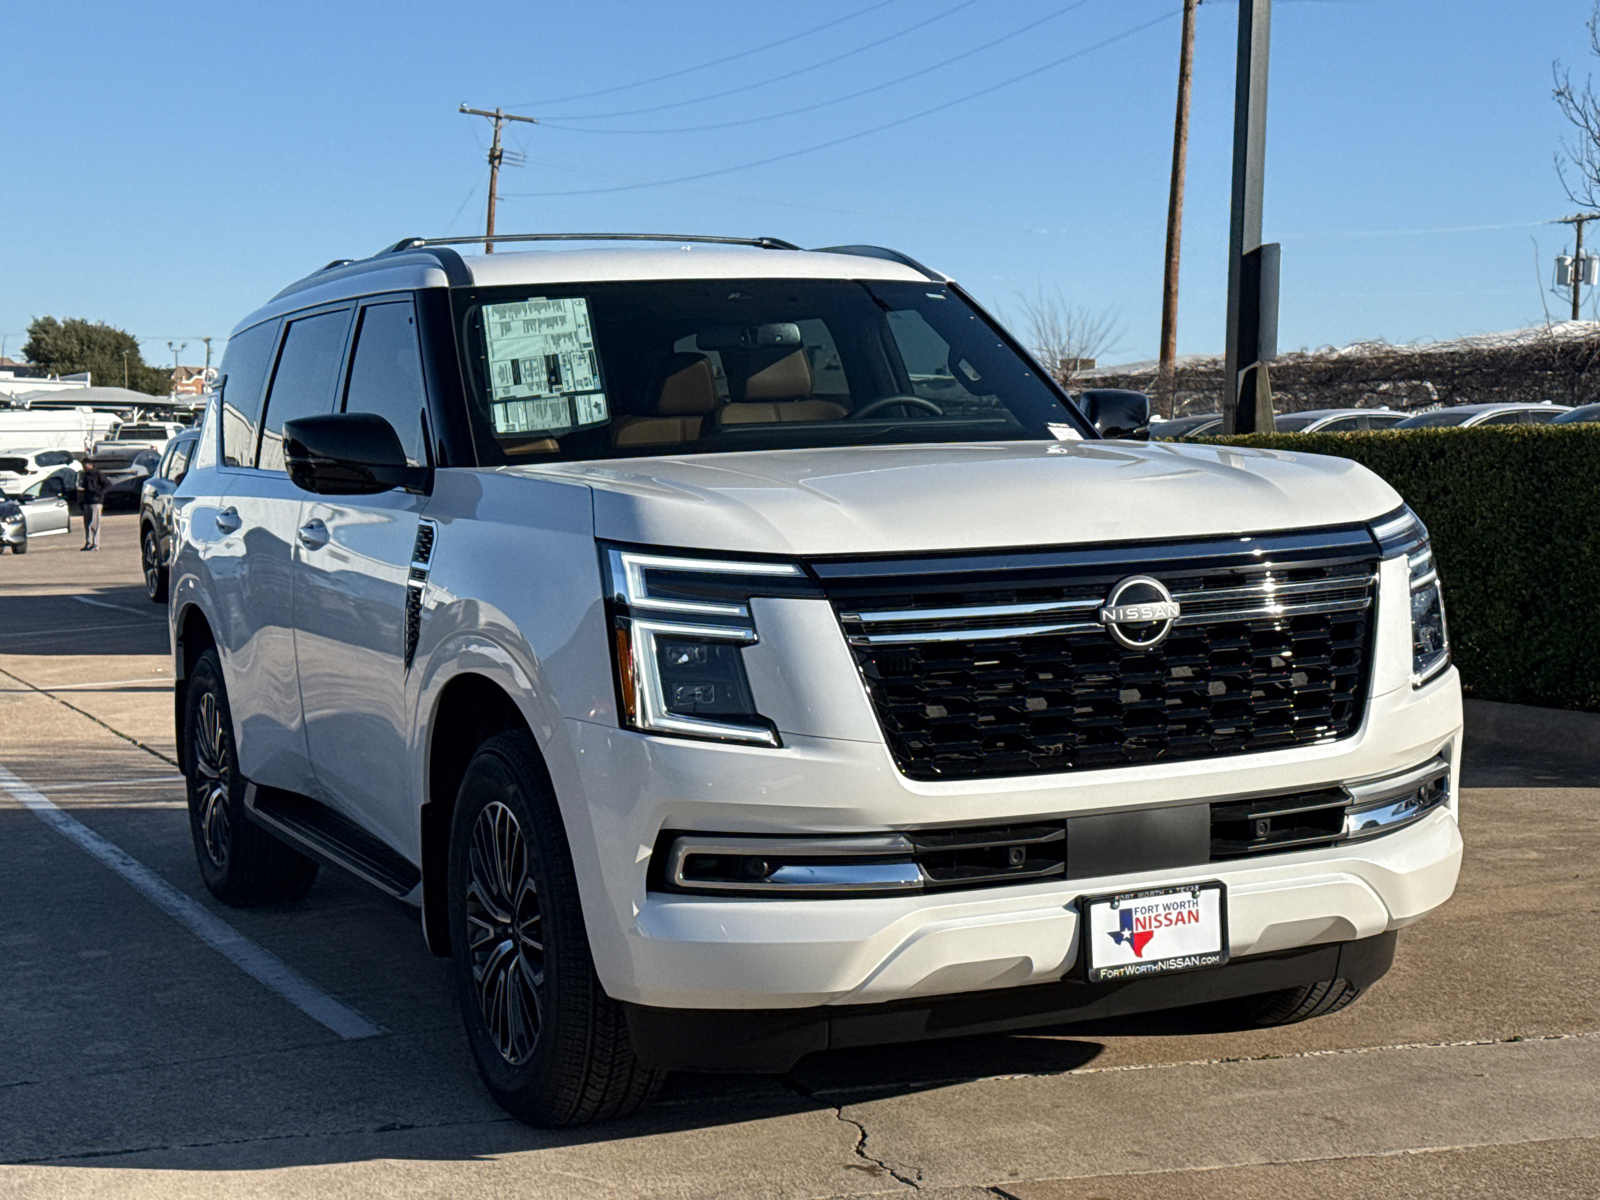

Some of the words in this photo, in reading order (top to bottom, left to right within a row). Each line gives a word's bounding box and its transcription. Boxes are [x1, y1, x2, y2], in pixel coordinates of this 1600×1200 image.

[1102, 606, 1178, 620] NISSAN
[1114, 893, 1135, 901] FORT
[1137, 889, 1165, 898] WORTH
[1175, 885, 1200, 893] TEXAS
[1134, 904, 1160, 915] FORT
[1162, 899, 1199, 912] WORTH
[1135, 909, 1200, 931] NISSAN
